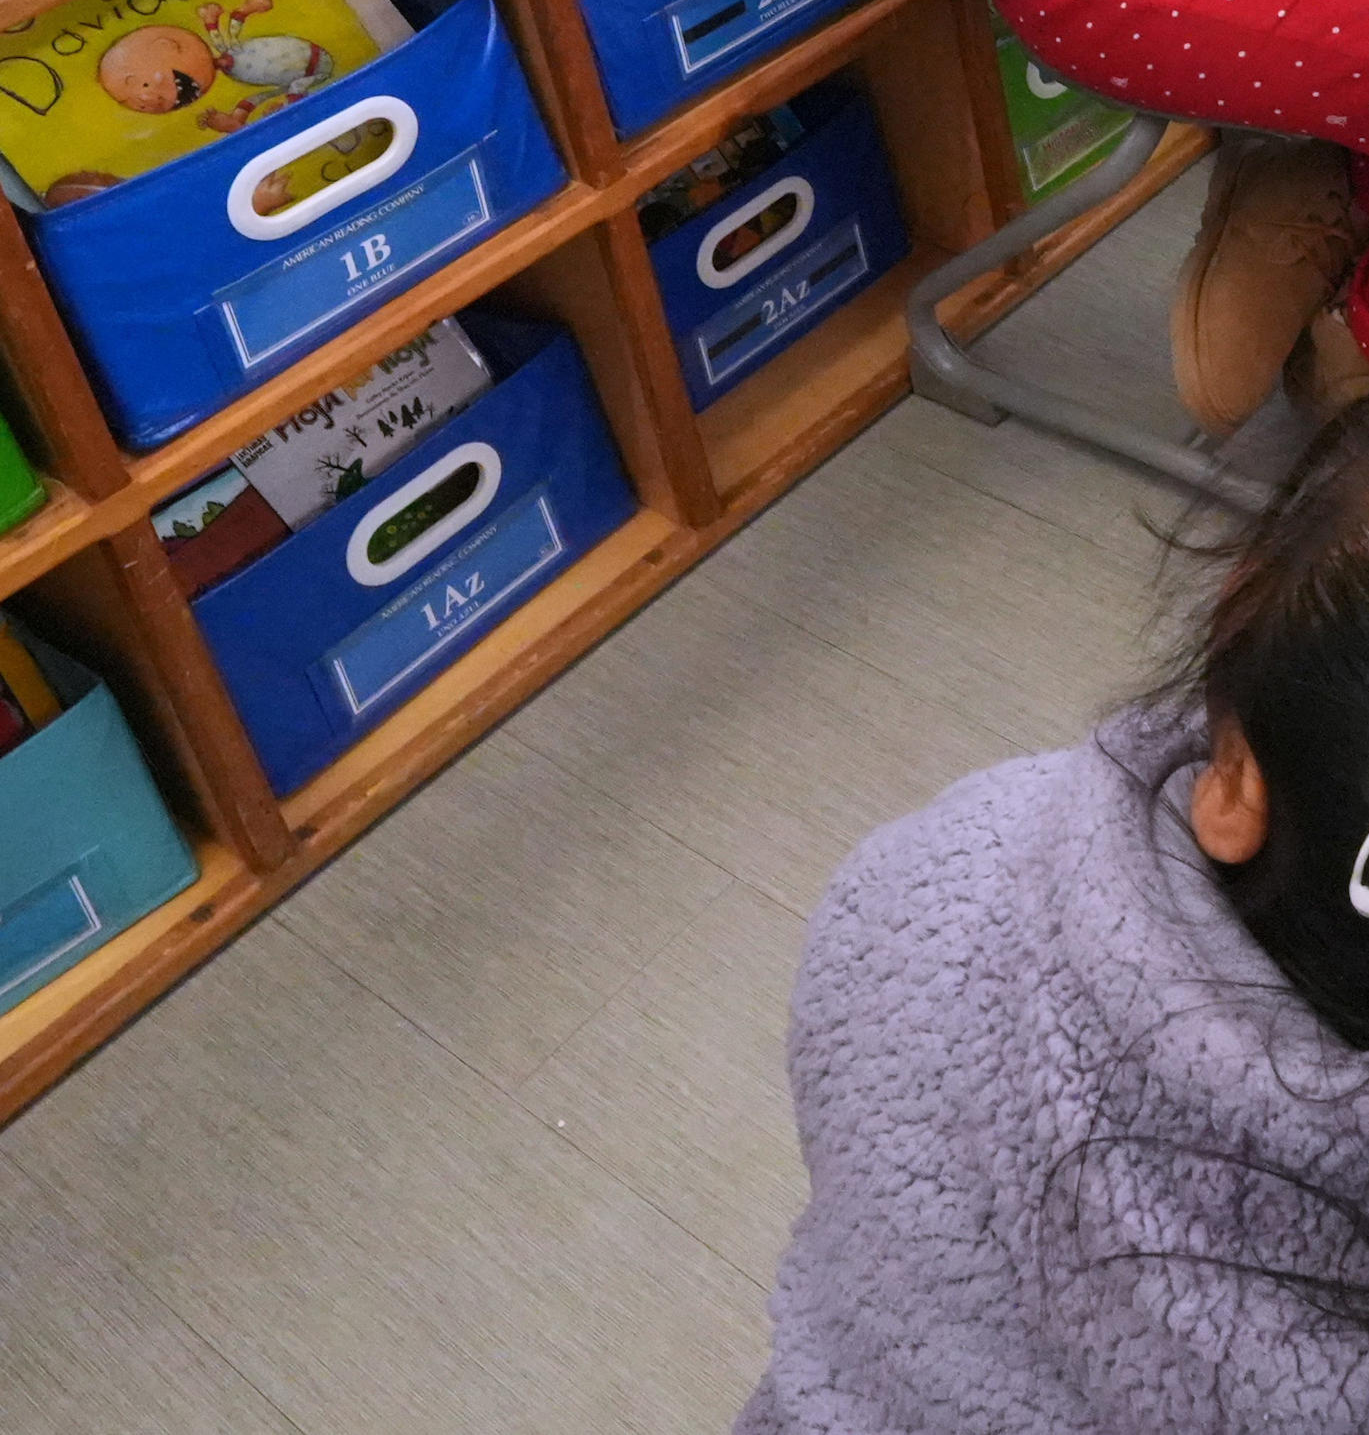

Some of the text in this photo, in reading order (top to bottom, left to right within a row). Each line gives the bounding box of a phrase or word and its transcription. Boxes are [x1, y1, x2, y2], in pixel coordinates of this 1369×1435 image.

[281, 184, 426, 271] AMERICAN READING COMPANY
[341, 232, 392, 283] 1B
[346, 263, 395, 297] ONE BLUE
[760, 279, 811, 326] 2Az
[420, 573, 488, 630] 1Az
